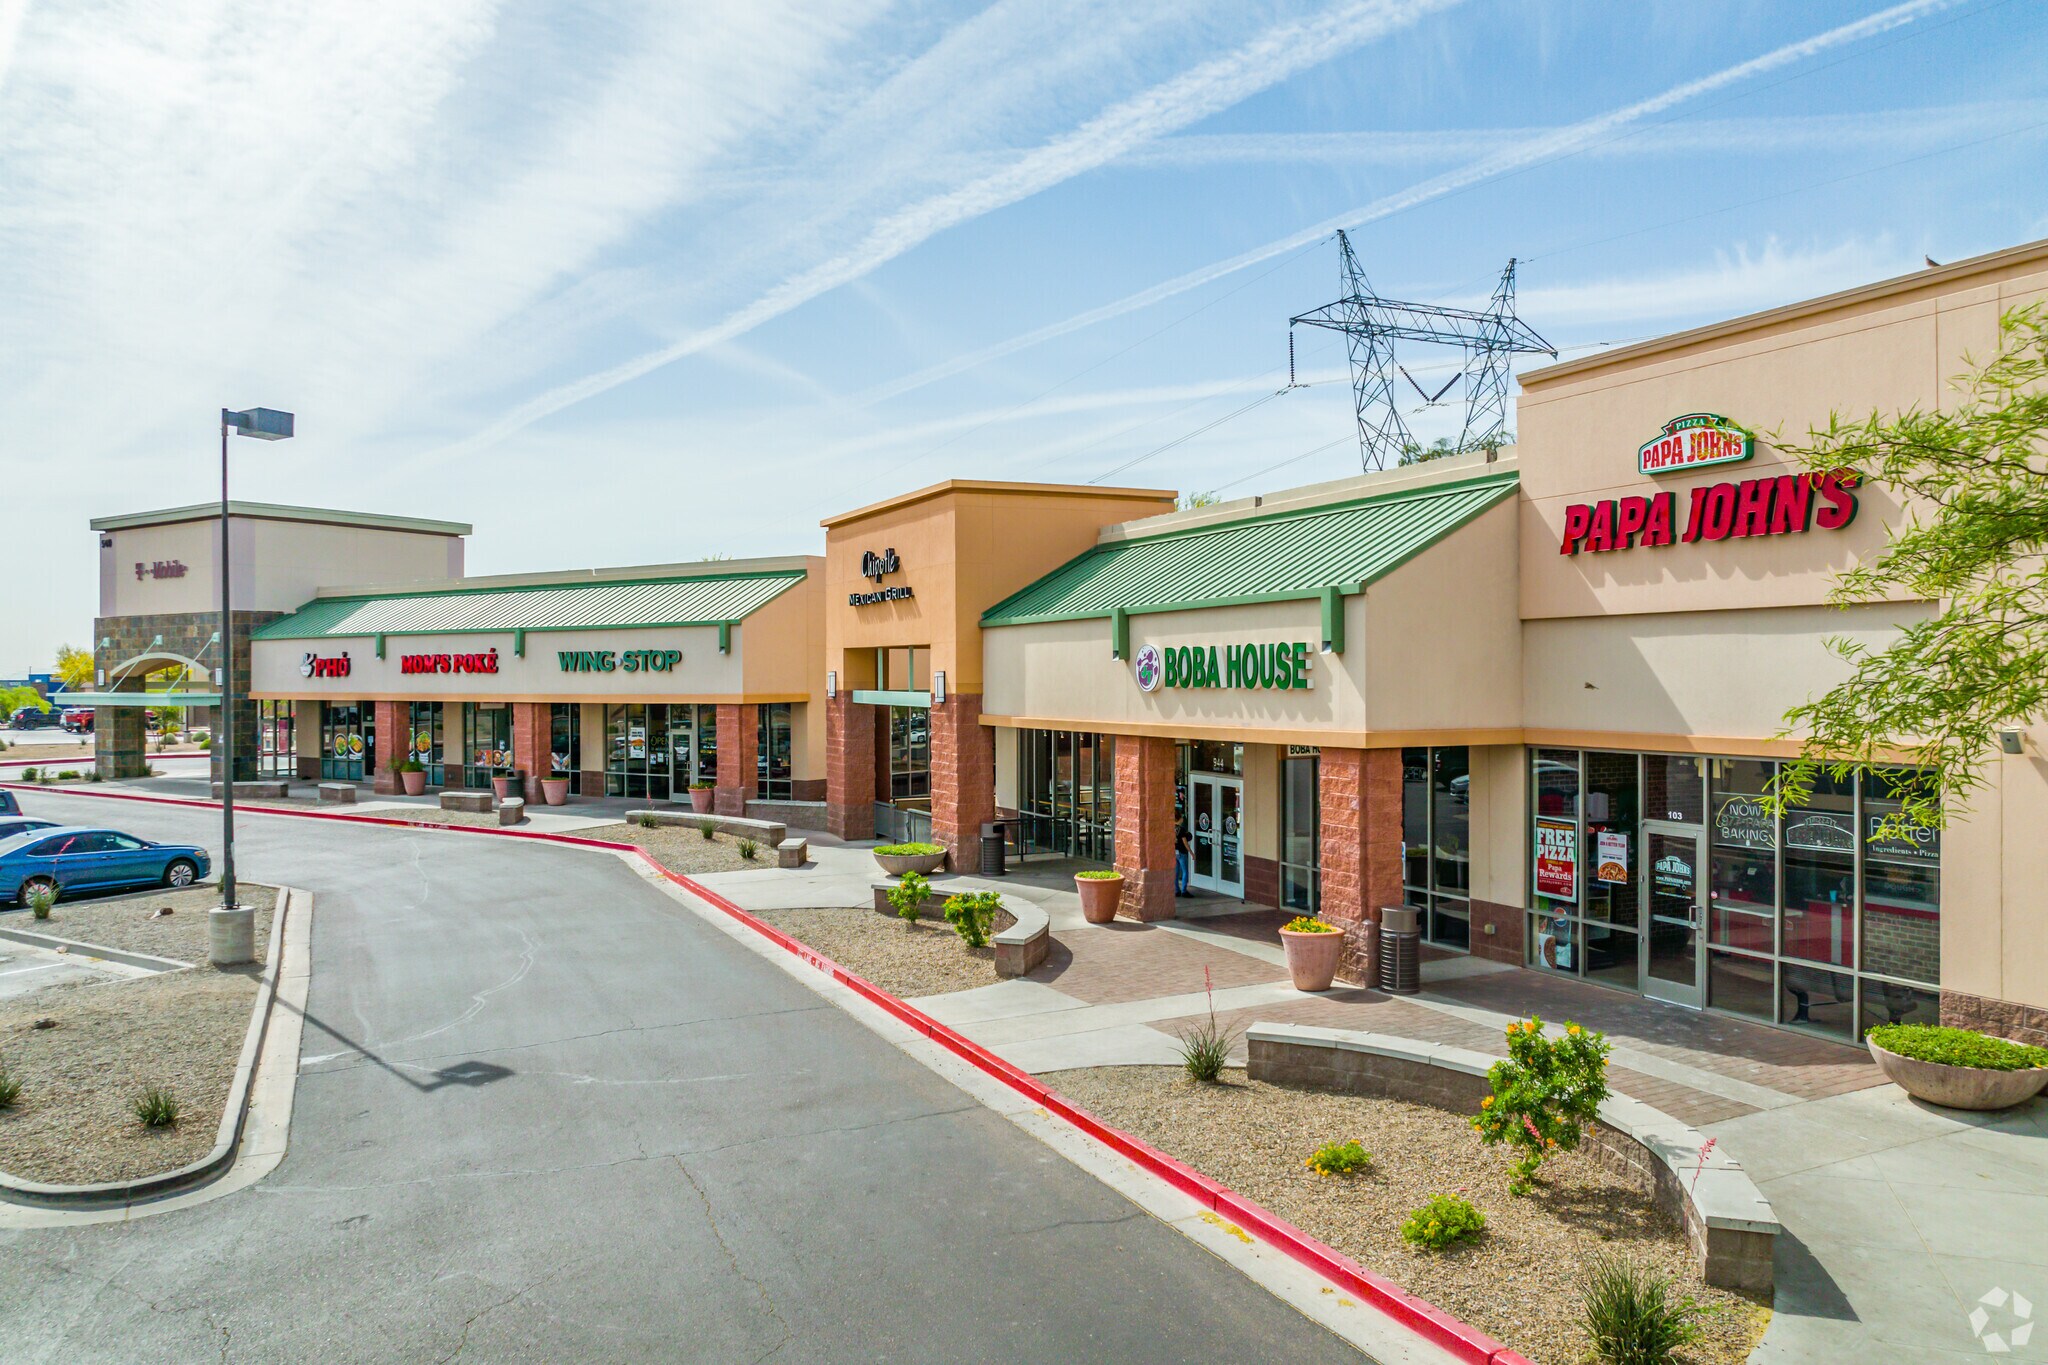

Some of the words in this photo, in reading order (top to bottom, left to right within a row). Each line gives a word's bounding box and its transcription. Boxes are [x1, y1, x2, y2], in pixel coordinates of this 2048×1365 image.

[1675, 418, 1705, 431] PIZZA
[1642, 435, 1685, 470] PAPA
[1686, 430, 1742, 463] JOHN'S
[1560, 491, 1676, 556] PAPA
[1682, 467, 1863, 543] JOHN'S
[861, 547, 900, 584] Chipotle
[849, 592, 885, 607] MEXICAN
[885, 586, 914, 601] GRILL
[401, 654, 451, 674] MOM'S
[453, 647, 499, 674] POKÉ
[558, 650, 616, 672] WING
[622, 649, 682, 672] STOP
[1164, 645, 1224, 690] BOBA
[1226, 641, 1312, 691] HOUSE
[1290, 744, 1310, 754] BOBA
[1213, 757, 1224, 768] 944
[1667, 811, 1683, 820] 103
[1729, 804, 1761, 816] NOW
[1537, 826, 1575, 847] FREE
[1721, 826, 1769, 842] BAKING
[1536, 843, 1576, 863] PIZZA
[1872, 844, 1912, 855] Ingredients
[1919, 849, 1939, 858] Pizza
[1547, 863, 1563, 873] Papa
[1656, 861, 1671, 871] PAPA
[1538, 868, 1573, 881] Rewards
